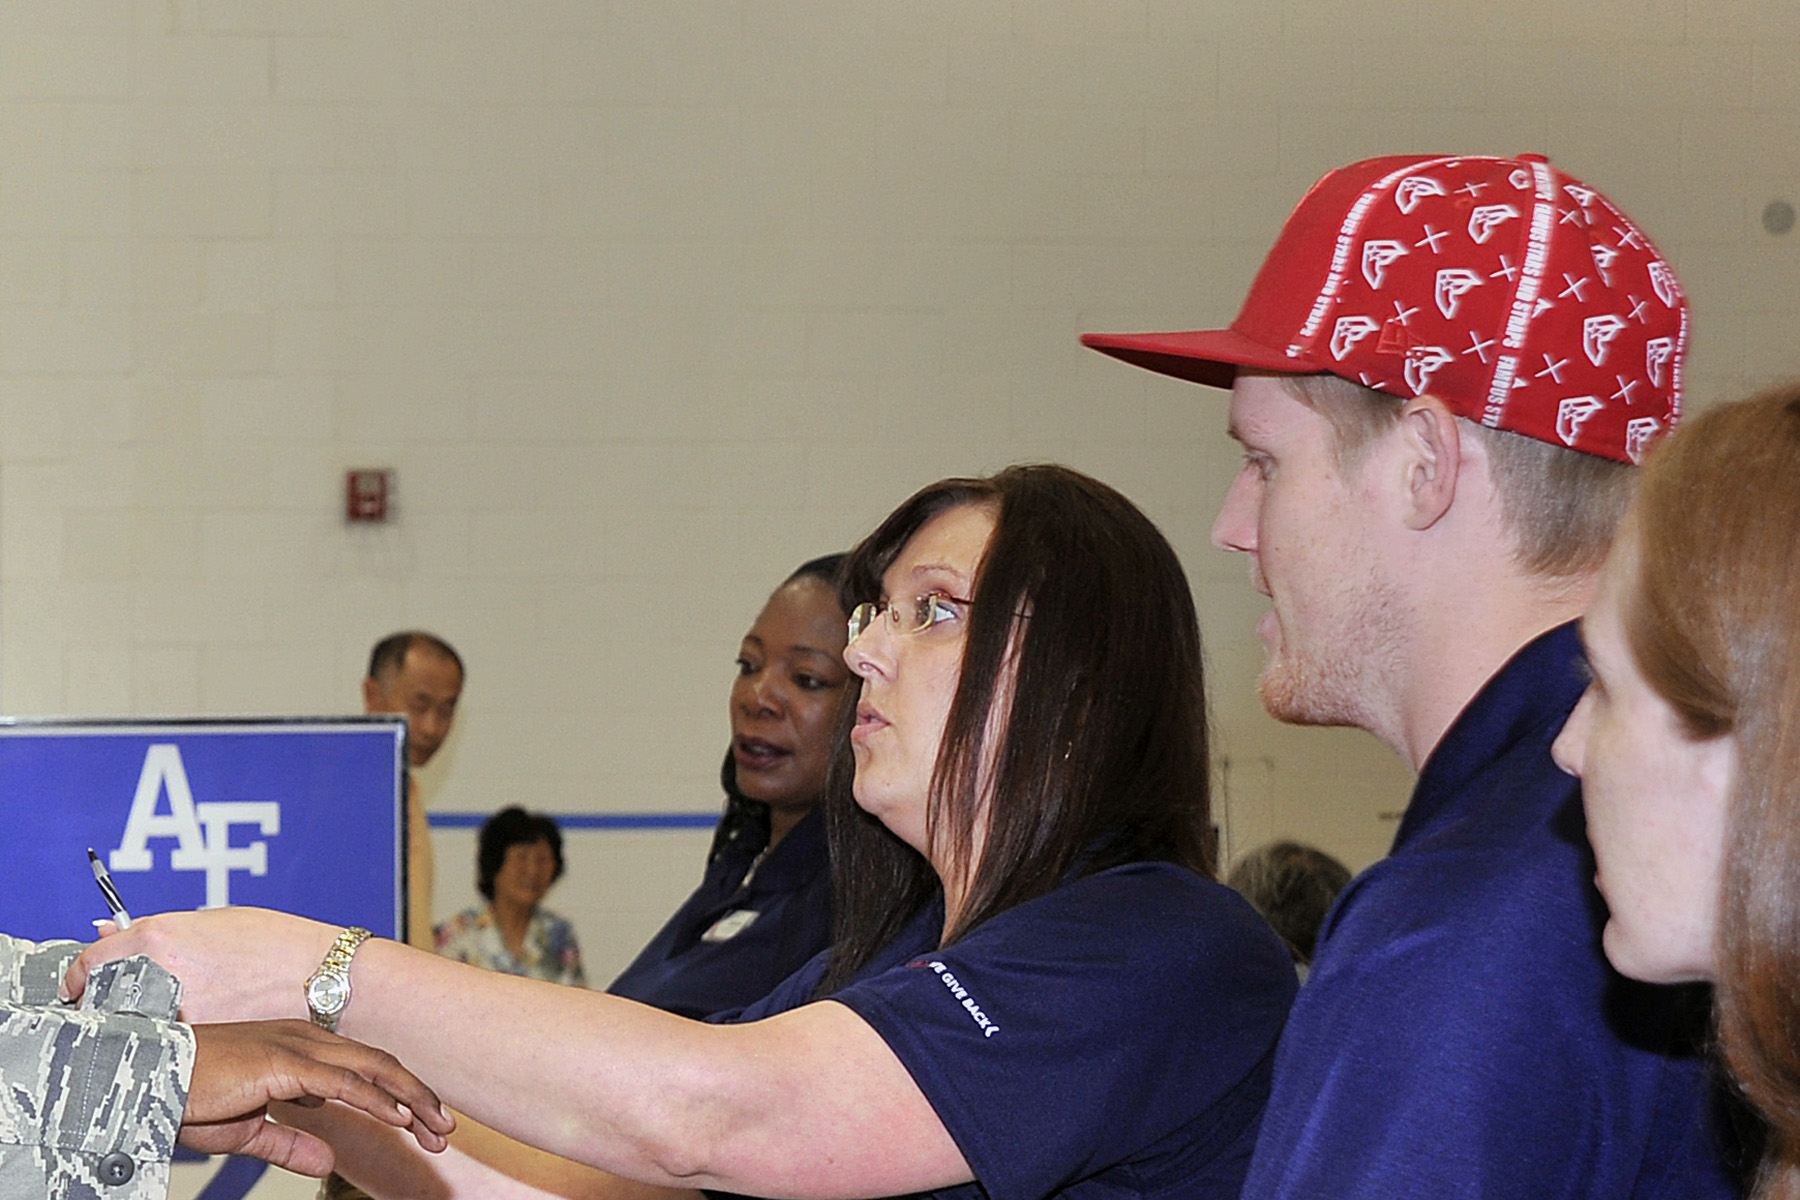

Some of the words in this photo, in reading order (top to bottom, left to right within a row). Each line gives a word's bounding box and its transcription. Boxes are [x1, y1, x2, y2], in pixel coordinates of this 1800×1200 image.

[1341, 193, 1375, 236] FAMOUS
[1528, 203, 1553, 243] FAMOUS
[1330, 234, 1353, 272] STARS
[1522, 241, 1546, 277] STARS
[1321, 272, 1343, 296] AND
[1515, 275, 1539, 302] AND
[1299, 295, 1332, 337] STRAPS
[1502, 301, 1532, 349] STRAPS
[1487, 355, 1517, 405] FAMOUS
[110, 743, 281, 910] AF
[941, 972, 968, 1000] GIVE
[961, 997, 992, 1030] BACK
